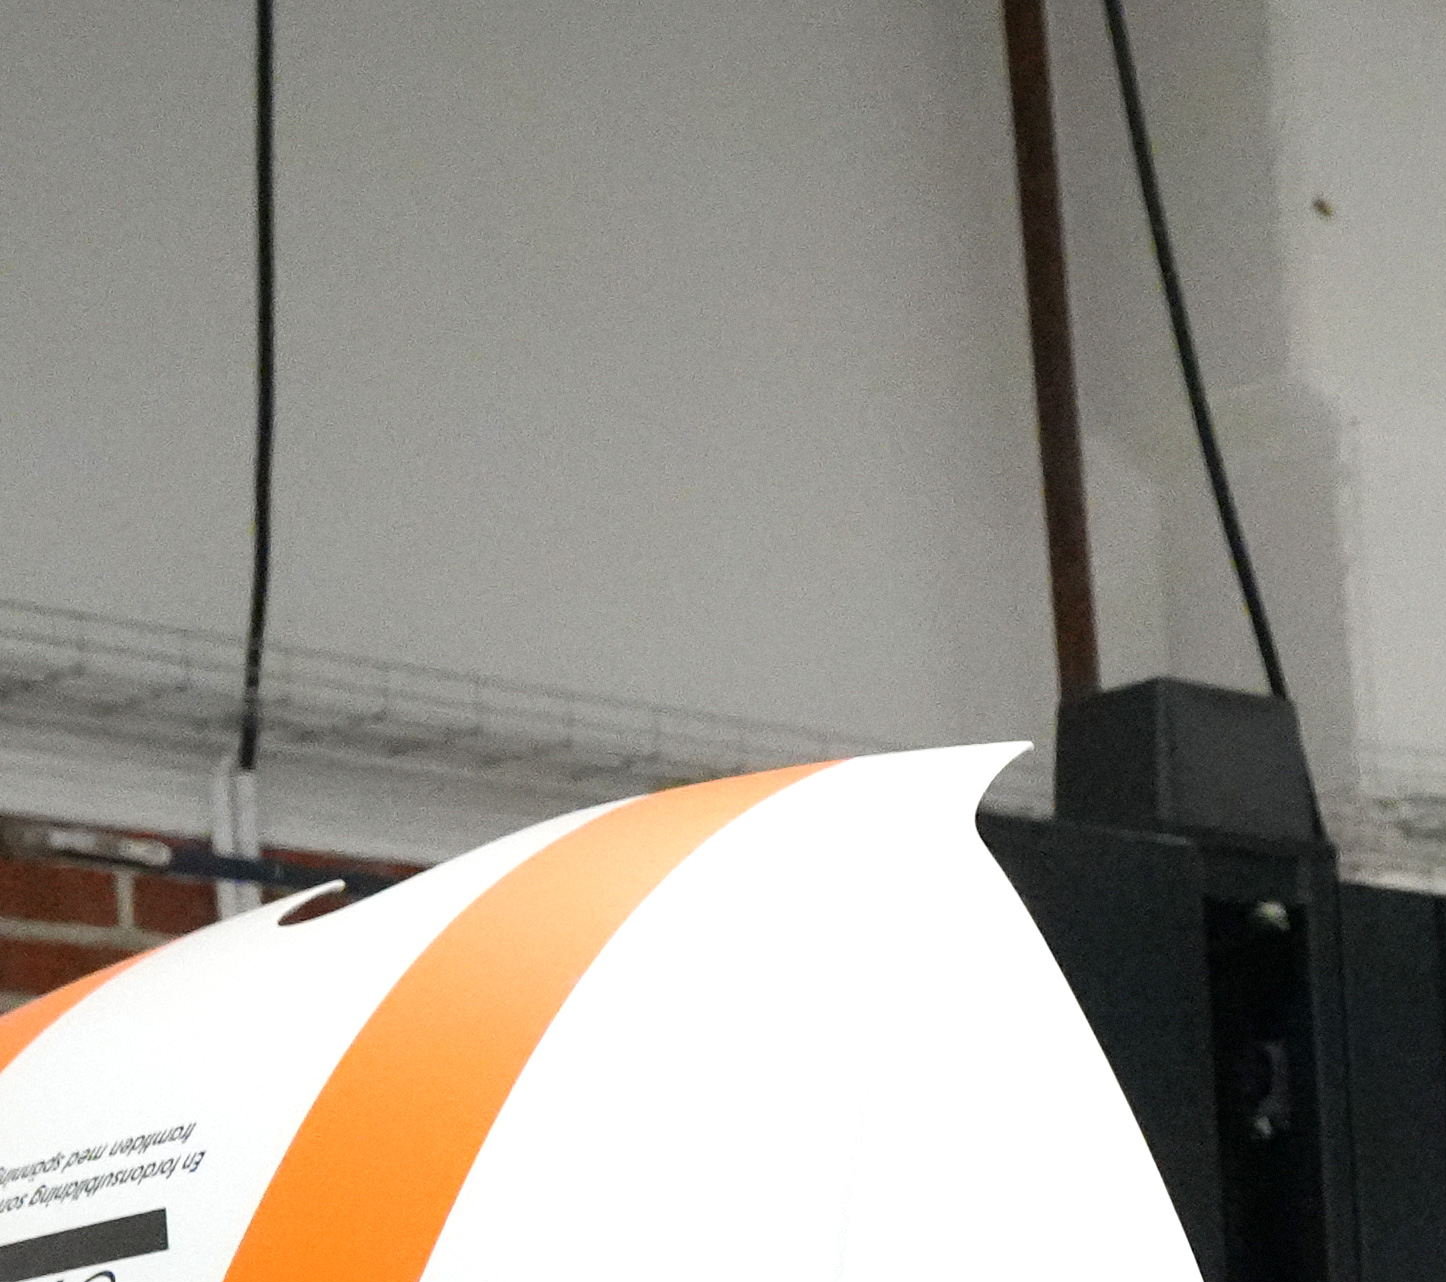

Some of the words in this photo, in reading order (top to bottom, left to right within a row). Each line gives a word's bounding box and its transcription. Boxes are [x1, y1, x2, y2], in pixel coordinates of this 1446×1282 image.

[109, 1122, 198, 1156] framtiden
[64, 1144, 108, 1173] med
[183, 1151, 206, 1173] En
